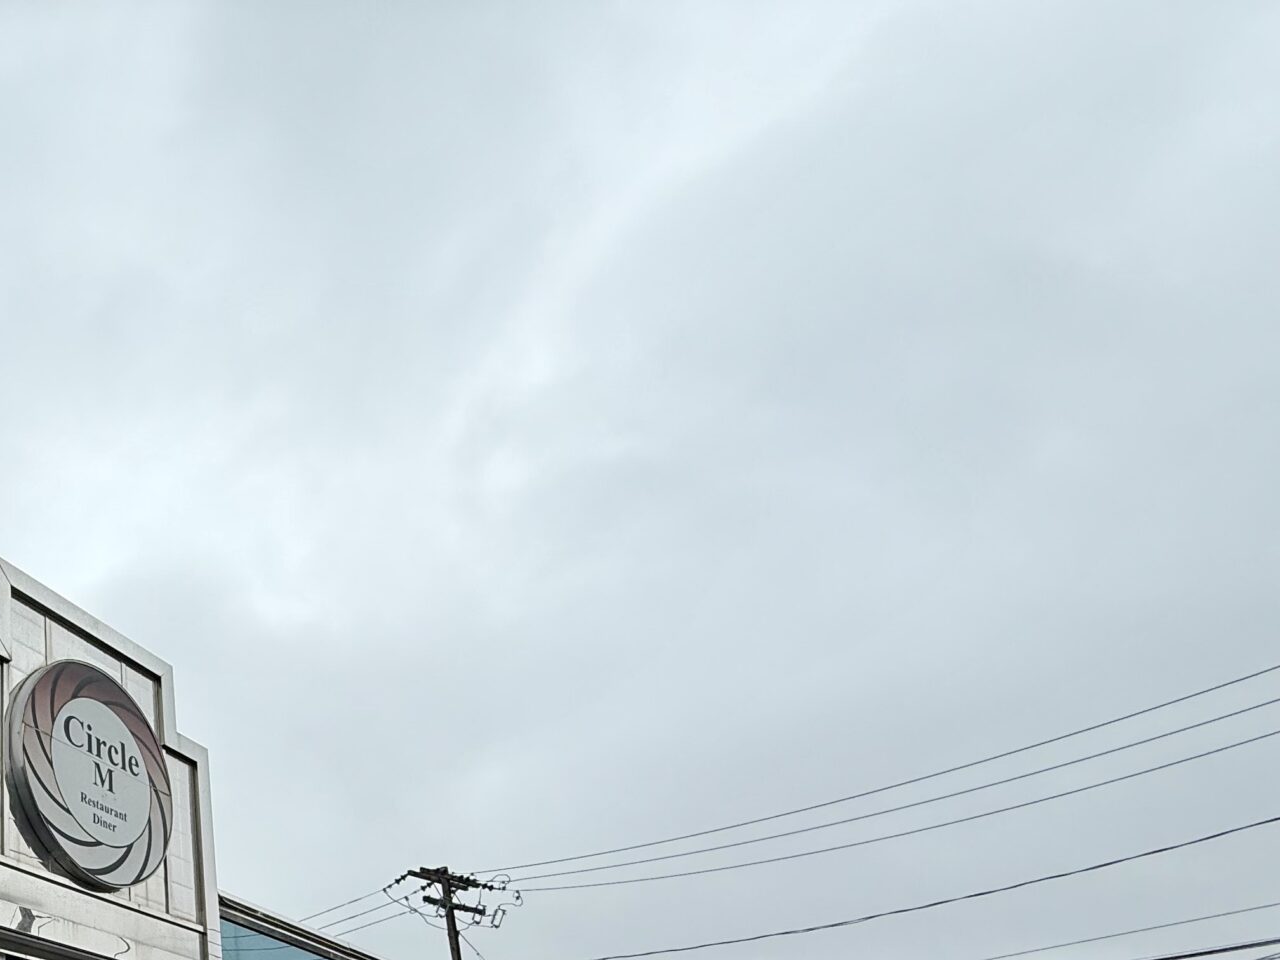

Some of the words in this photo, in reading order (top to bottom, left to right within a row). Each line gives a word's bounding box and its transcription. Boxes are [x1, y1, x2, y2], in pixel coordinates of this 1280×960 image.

[63, 715, 140, 777] Circle
[92, 760, 116, 795] M
[80, 791, 128, 822] Restaurant
[92, 813, 117, 833] Diner
